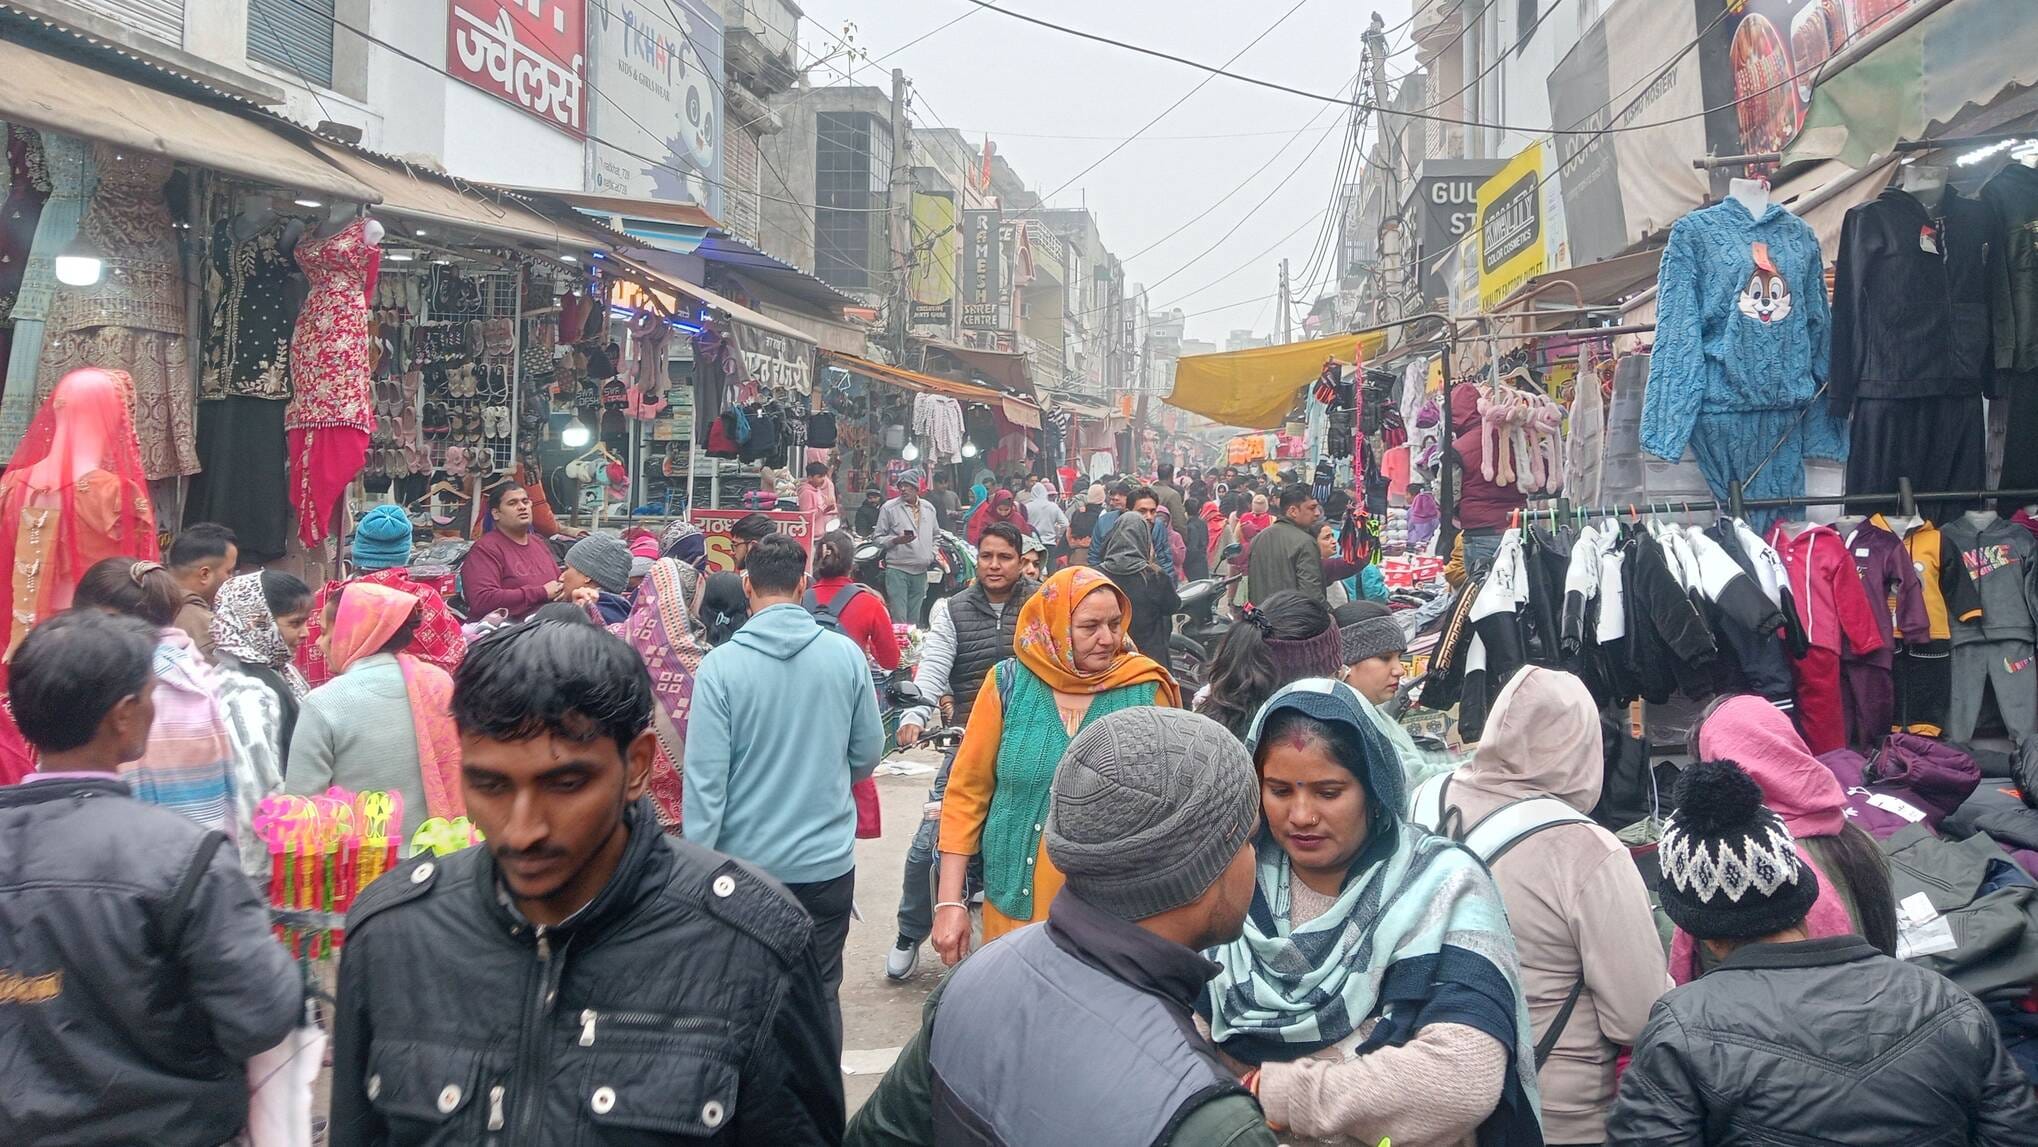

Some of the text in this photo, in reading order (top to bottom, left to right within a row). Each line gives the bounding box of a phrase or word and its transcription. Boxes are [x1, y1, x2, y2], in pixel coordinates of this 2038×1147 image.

[1562, 107, 1605, 178] JOCKEY
[1431, 182, 1478, 205] GUL
[1450, 212, 1477, 235] ST
[975, 215, 989, 304] RAMESH
[1487, 228, 1531, 267] COLOR COSMETICS
[963, 314, 998, 326] CENTRE
[1962, 544, 2010, 570] NIKE
